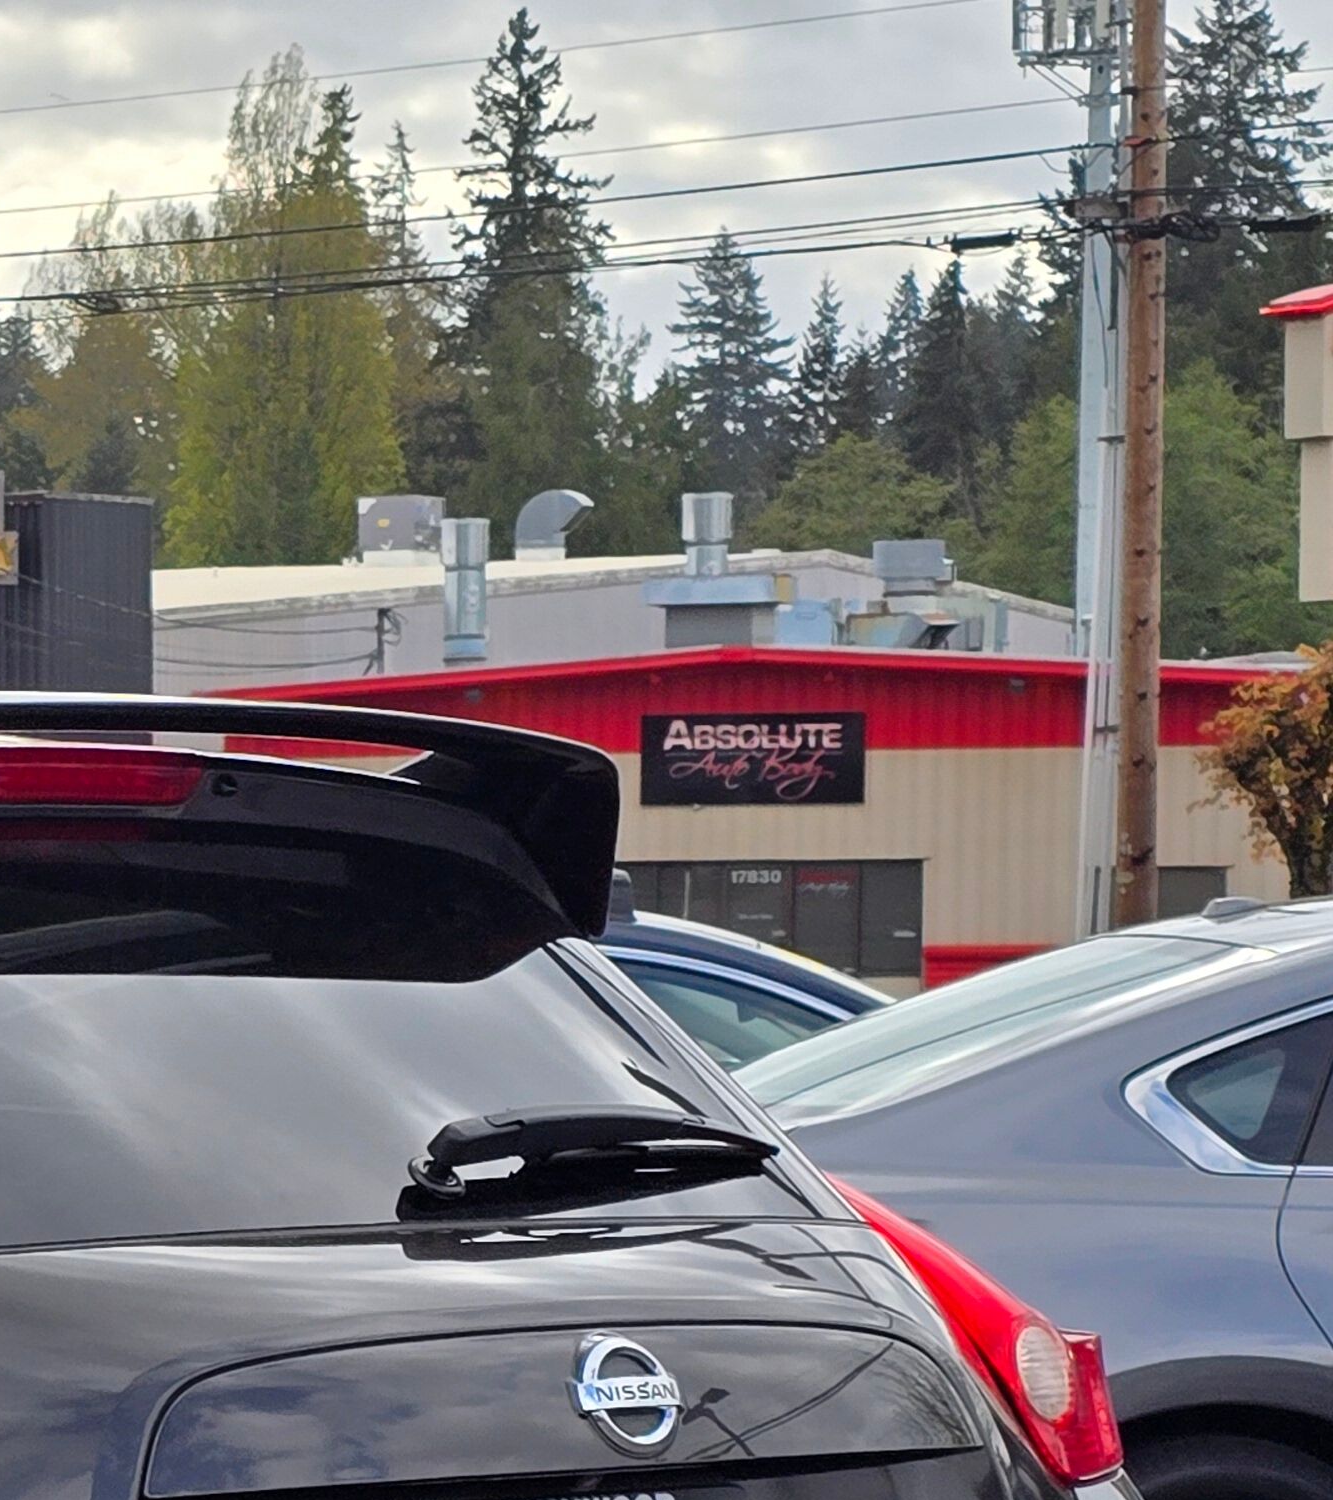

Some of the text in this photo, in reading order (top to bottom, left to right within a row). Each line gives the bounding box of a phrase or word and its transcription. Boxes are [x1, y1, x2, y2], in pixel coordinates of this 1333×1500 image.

[663, 719, 843, 751] ABSOLUTE
[669, 746, 835, 800] Auto Body
[593, 1378, 677, 1403] NISSAN
